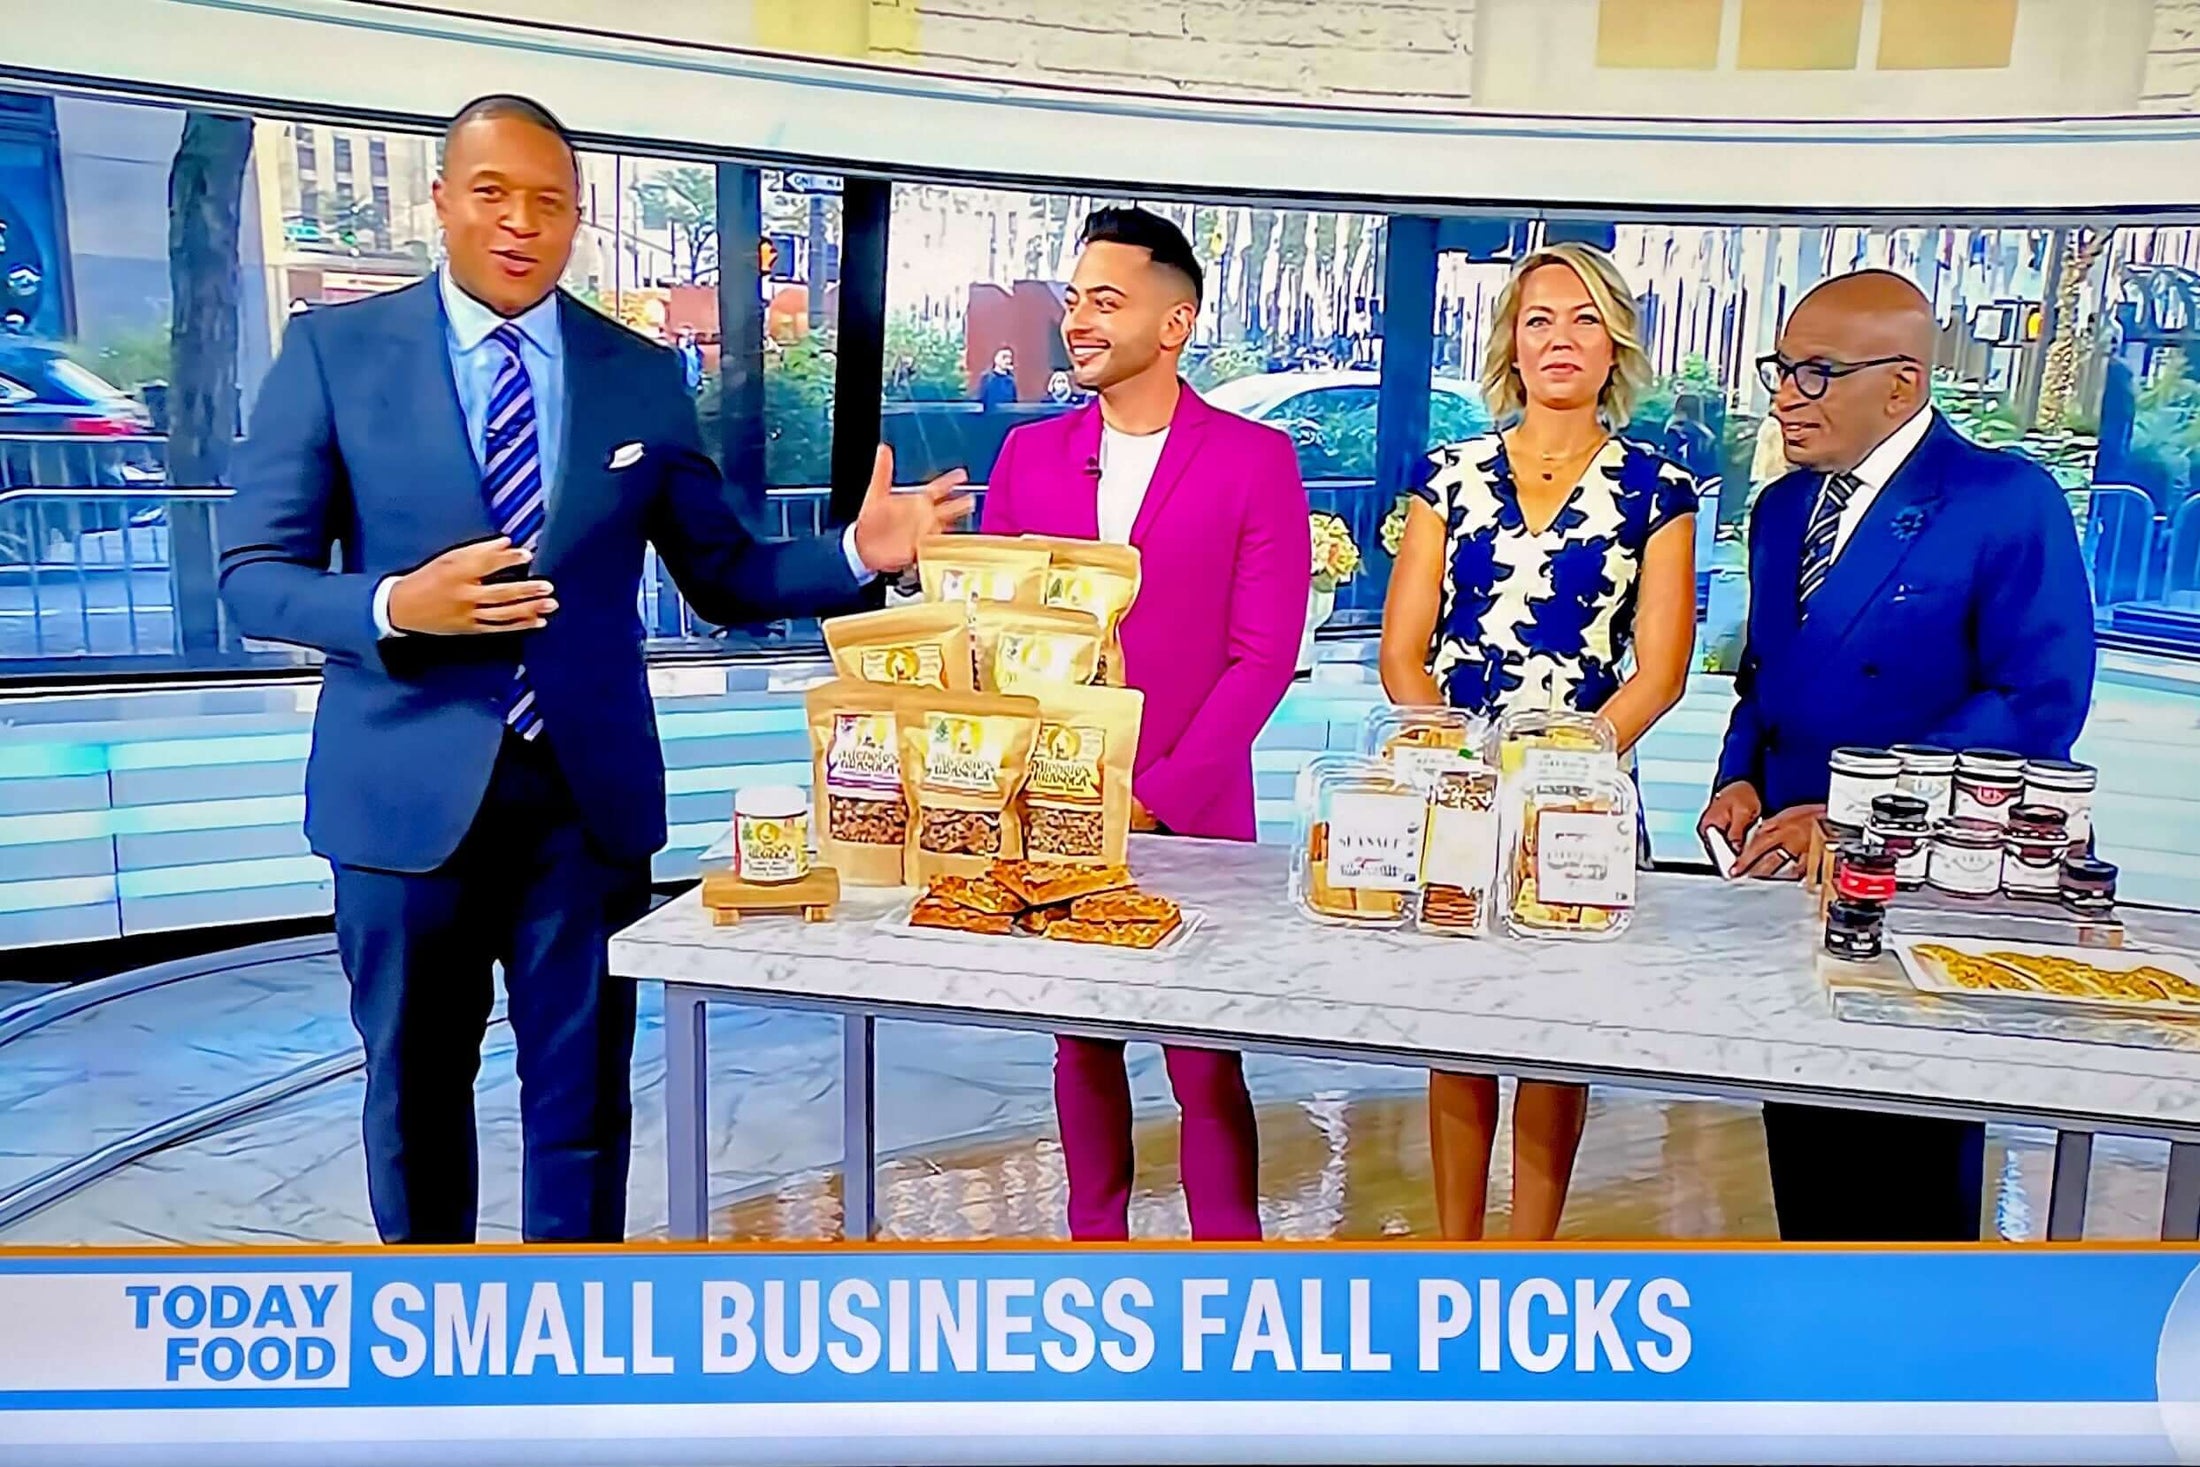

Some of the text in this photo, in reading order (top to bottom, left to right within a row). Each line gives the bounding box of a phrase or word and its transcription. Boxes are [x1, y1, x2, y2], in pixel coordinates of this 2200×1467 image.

[125, 1284, 338, 1330] TODAY
[371, 1277, 1692, 1377] SMALL BUSINESS FALL PICKS
[165, 1336, 336, 1382] FOOD
